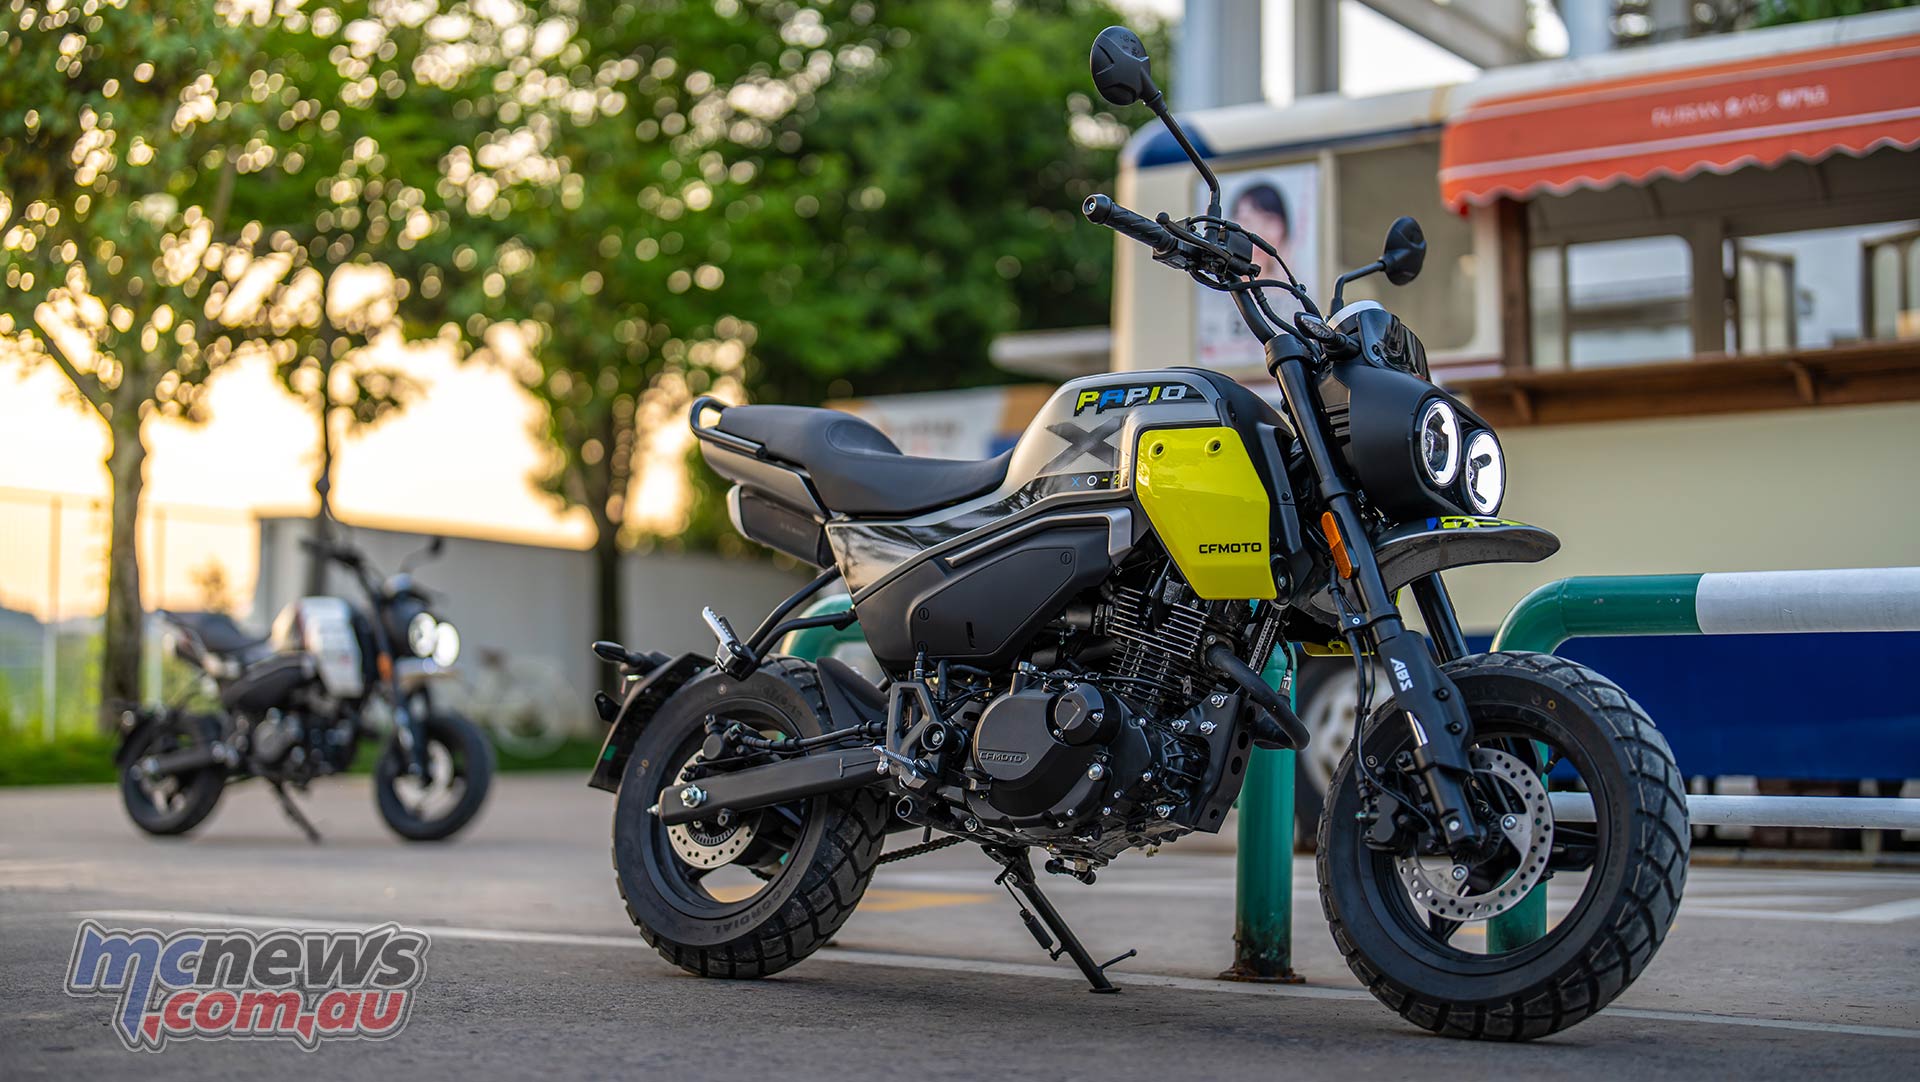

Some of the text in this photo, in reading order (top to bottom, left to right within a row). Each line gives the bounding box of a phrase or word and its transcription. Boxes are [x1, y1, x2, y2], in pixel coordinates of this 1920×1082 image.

[1075, 384, 1188, 412] PAPIO
[1199, 542, 1262, 554] CFMOTO
[1390, 657, 1413, 692] ABS
[979, 751, 1023, 763] CFMOTO
